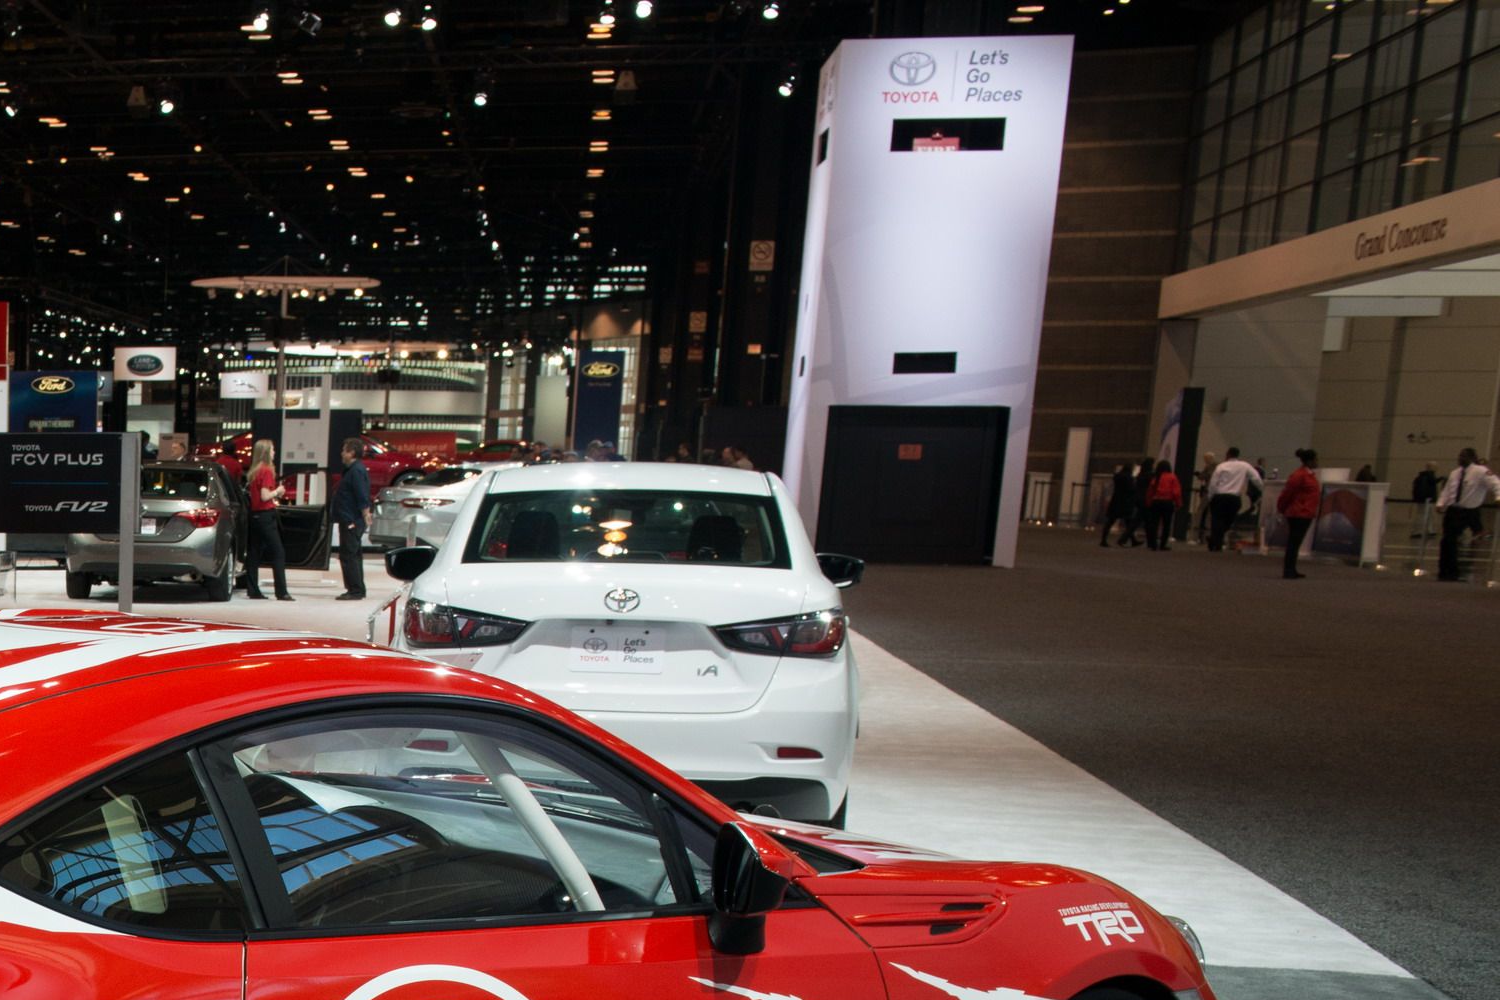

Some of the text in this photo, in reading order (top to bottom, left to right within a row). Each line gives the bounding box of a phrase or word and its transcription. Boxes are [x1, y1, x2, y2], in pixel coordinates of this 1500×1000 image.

[968, 49, 1010, 66] Let's
[966, 68, 991, 84] Go
[881, 91, 940, 104] TOYOTA
[964, 86, 1024, 103] Places
[1354, 217, 1448, 261] Grand Concourse
[10, 453, 104, 466] FCV PLUS
[24, 501, 109, 513] TOYOTA FV2
[623, 637, 646, 647] Let's
[622, 646, 637, 654] Go
[622, 654, 655, 664] Places
[1057, 905, 1081, 917] TOYOTA
[1062, 910, 1145, 947] TRD
